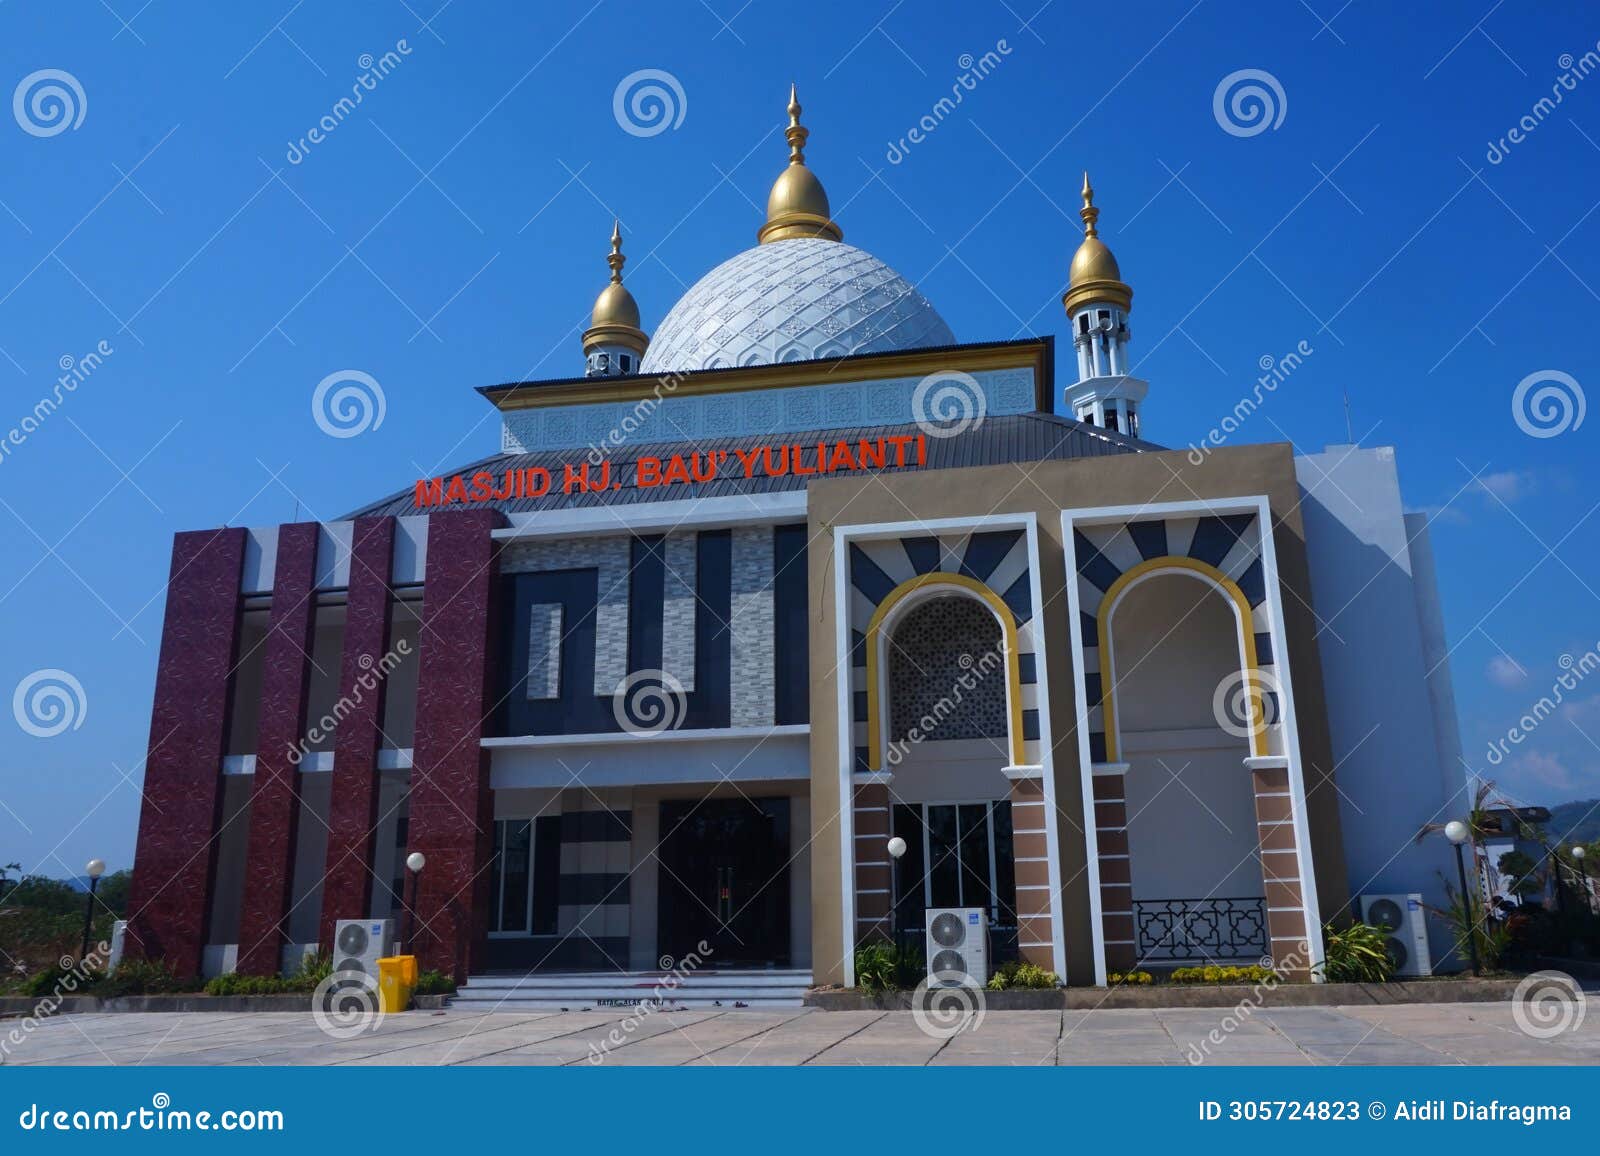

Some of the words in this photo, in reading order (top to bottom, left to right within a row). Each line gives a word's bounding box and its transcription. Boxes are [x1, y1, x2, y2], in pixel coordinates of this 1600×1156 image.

[414, 466, 551, 508] MASJID
[563, 460, 621, 495] HJ.
[735, 434, 925, 479] YULIANTI
